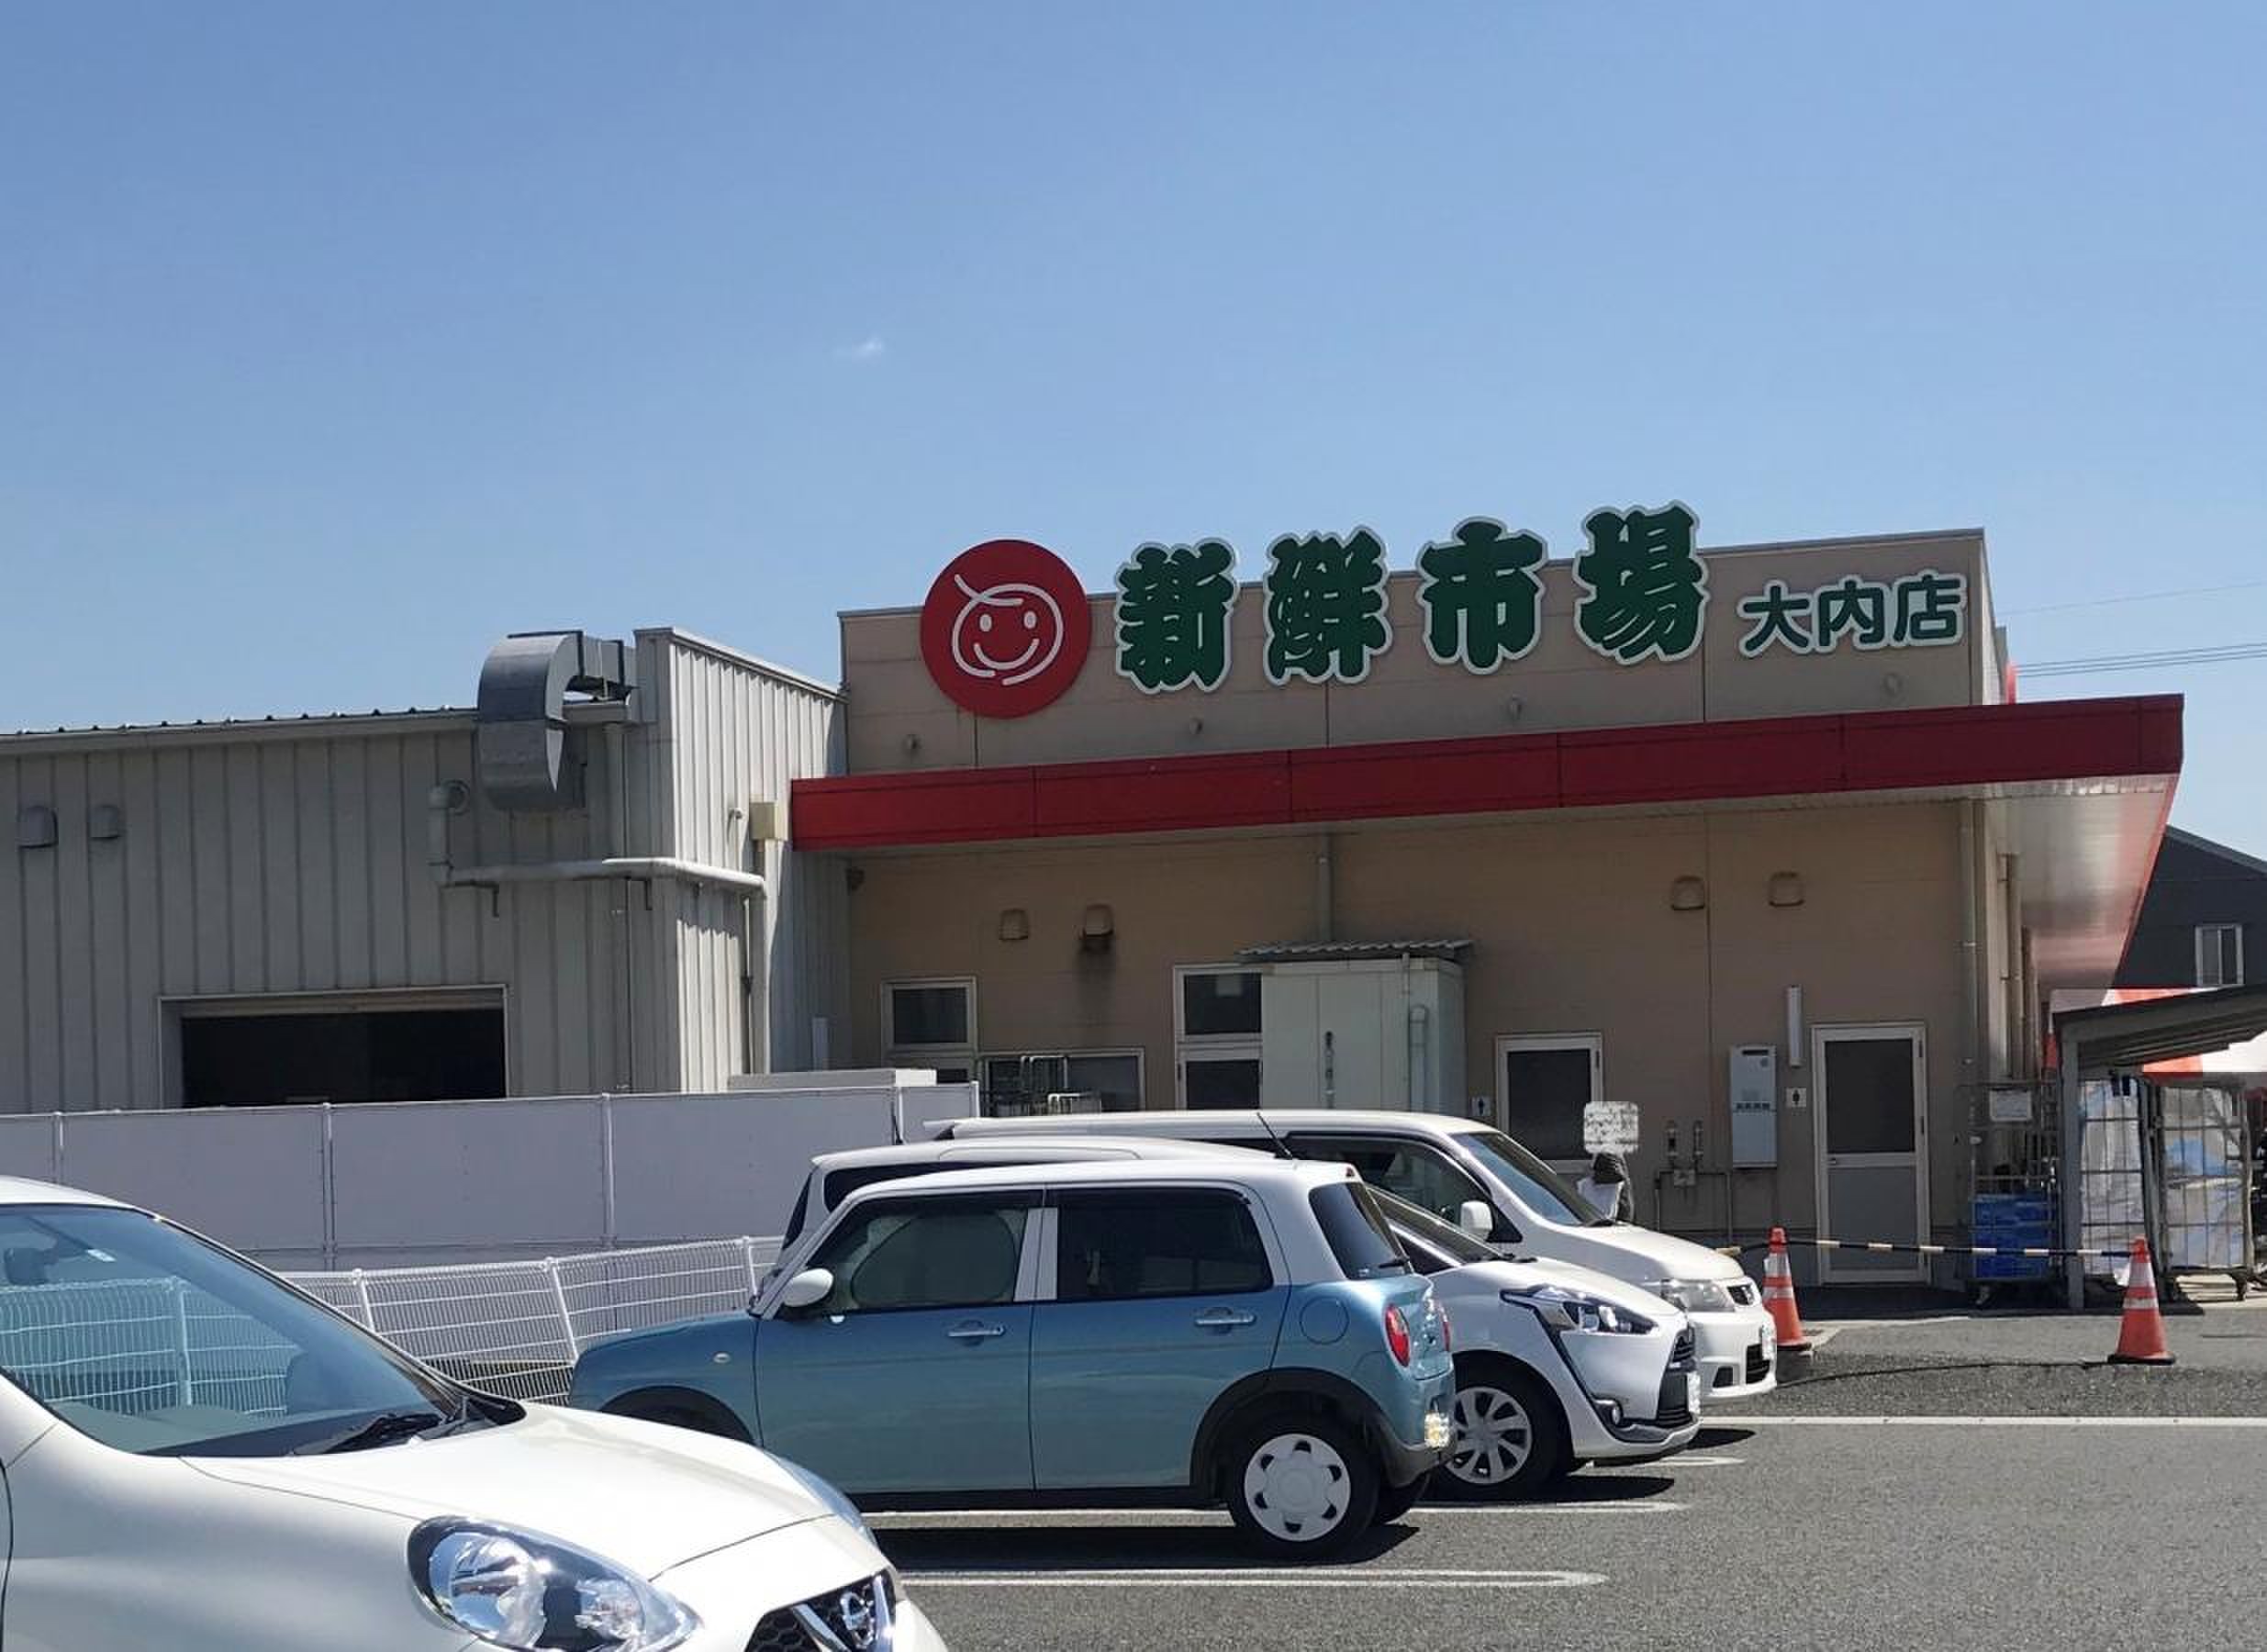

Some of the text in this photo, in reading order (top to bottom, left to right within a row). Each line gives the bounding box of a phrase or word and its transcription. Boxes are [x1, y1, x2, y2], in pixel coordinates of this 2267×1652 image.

[1116, 502, 1964, 691] 新鮮市場 大内店
